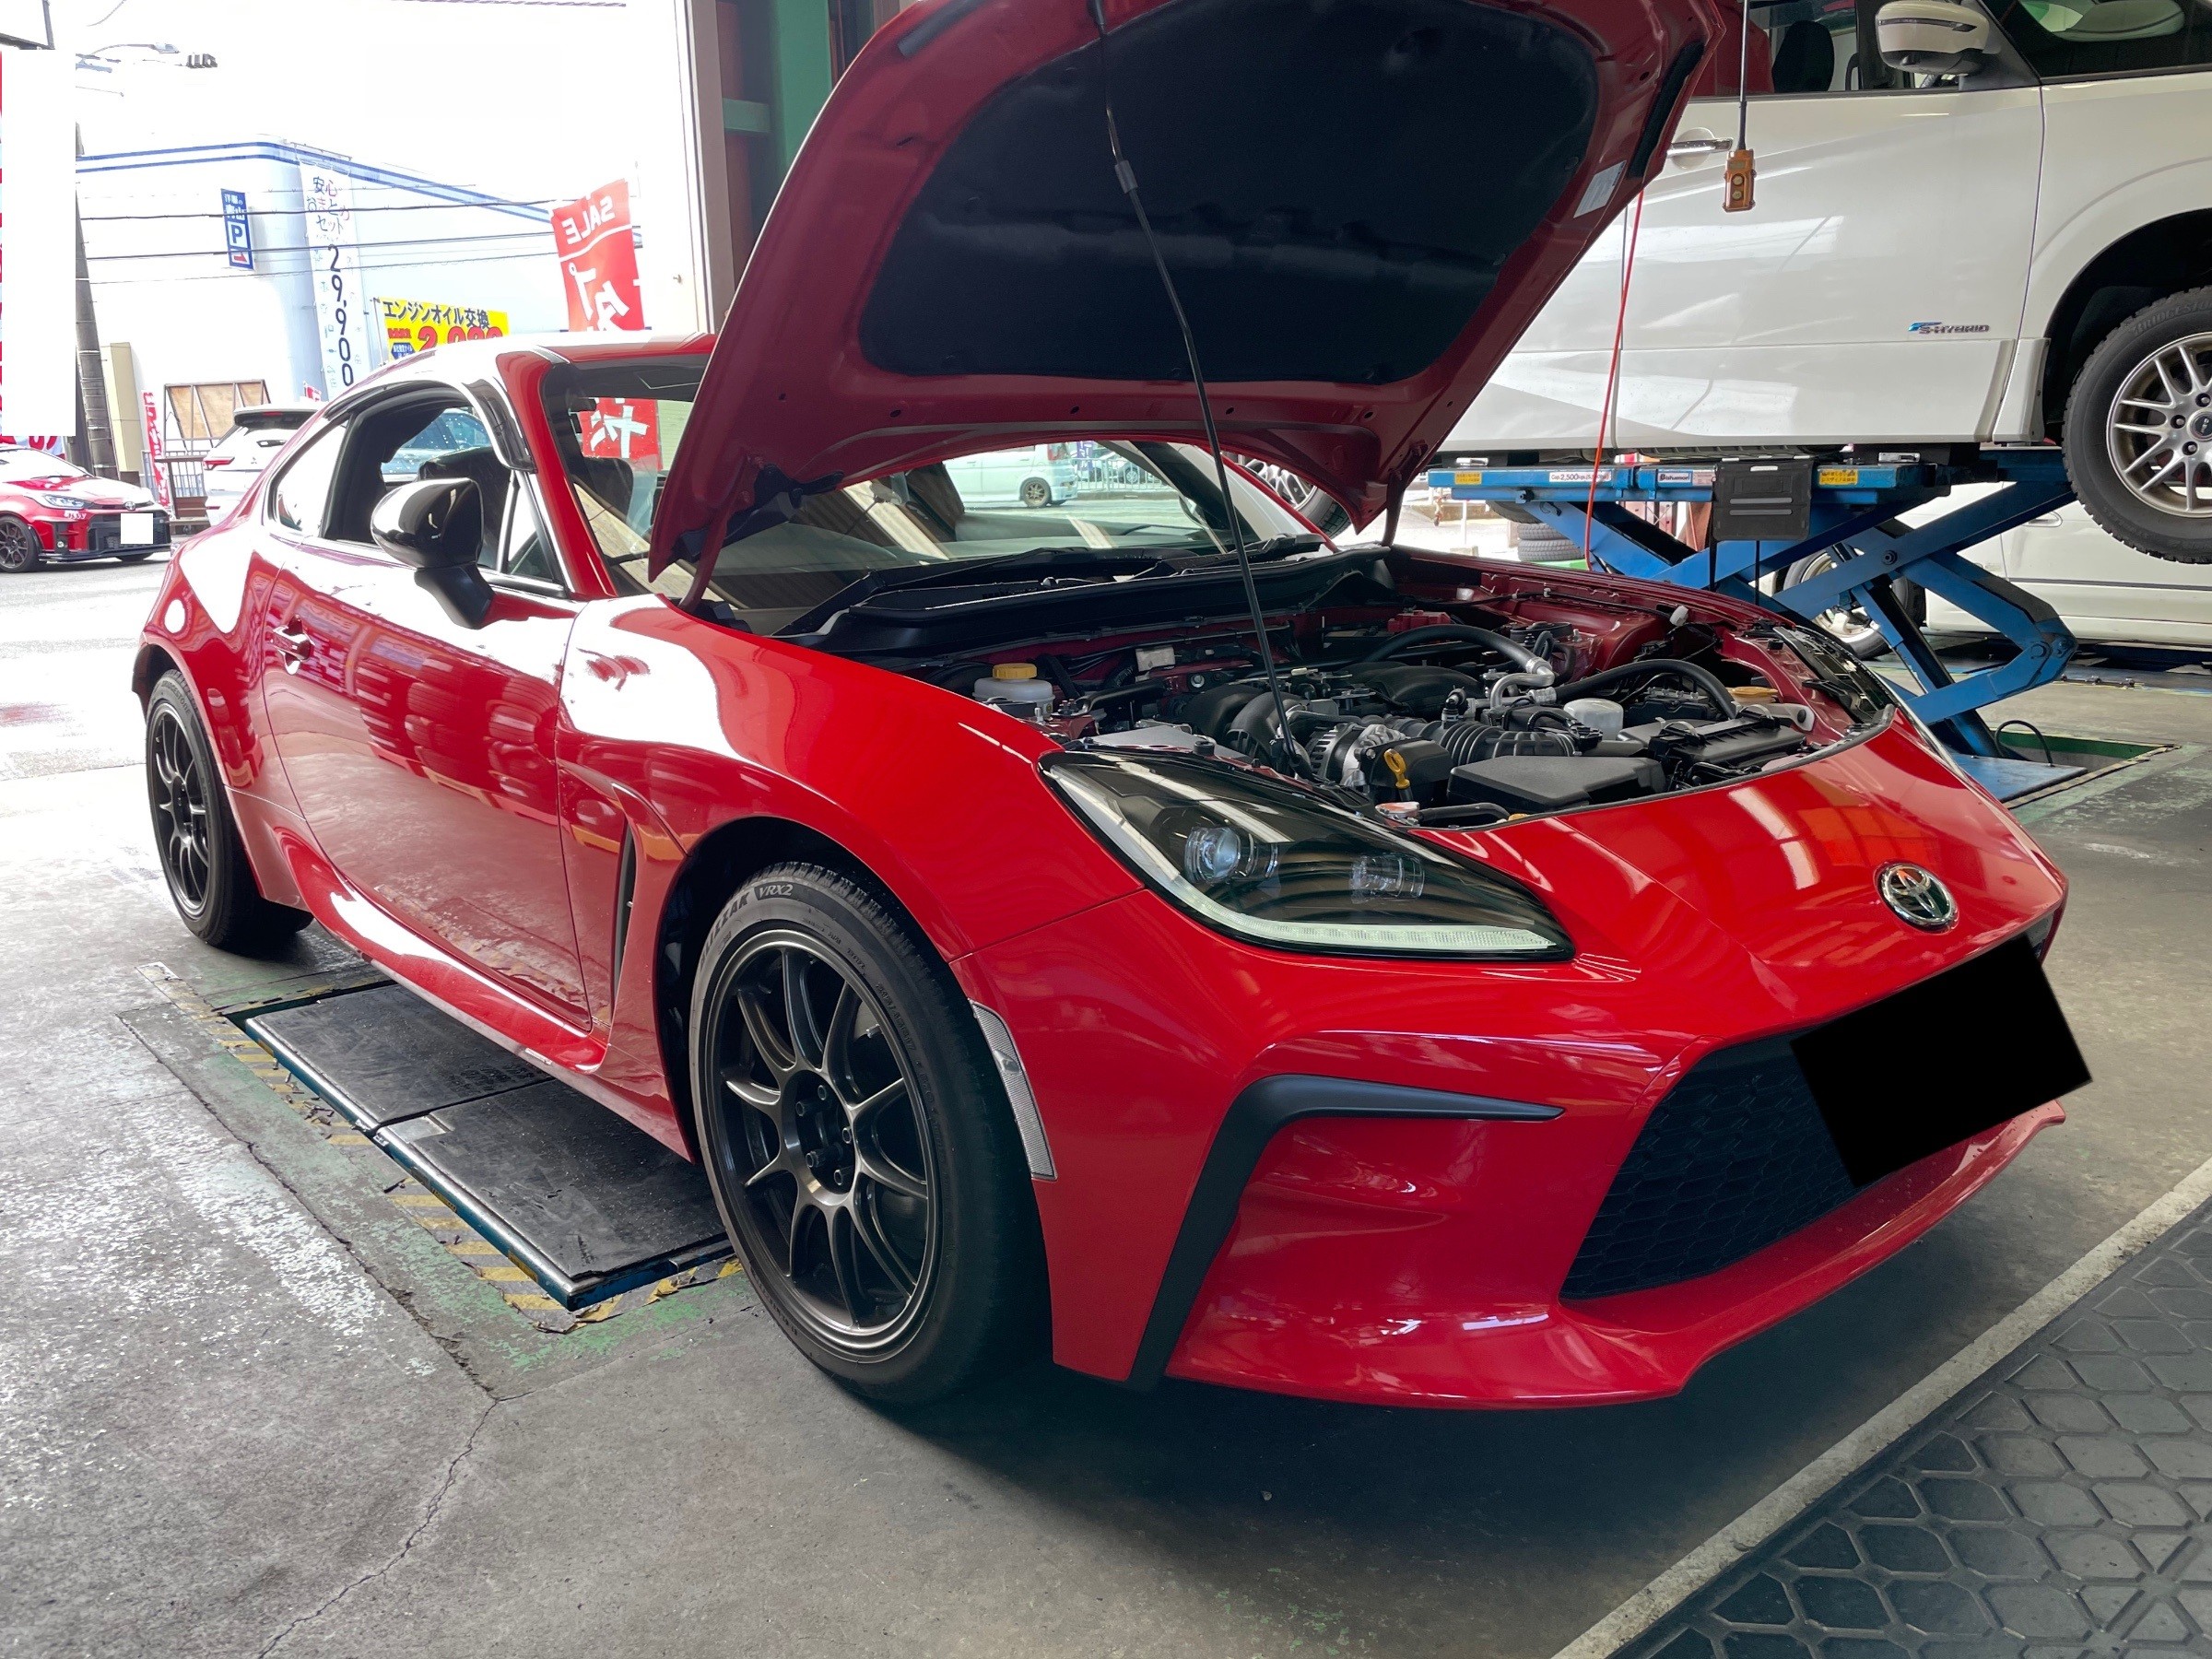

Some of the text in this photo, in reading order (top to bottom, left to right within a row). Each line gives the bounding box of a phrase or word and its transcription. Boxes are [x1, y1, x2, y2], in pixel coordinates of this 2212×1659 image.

[231, 224, 242, 243] P
[328, 244, 354, 386] 29,900
[382, 300, 490, 330] エンジンオイル交換
[759, 883, 794, 897] VRX2
